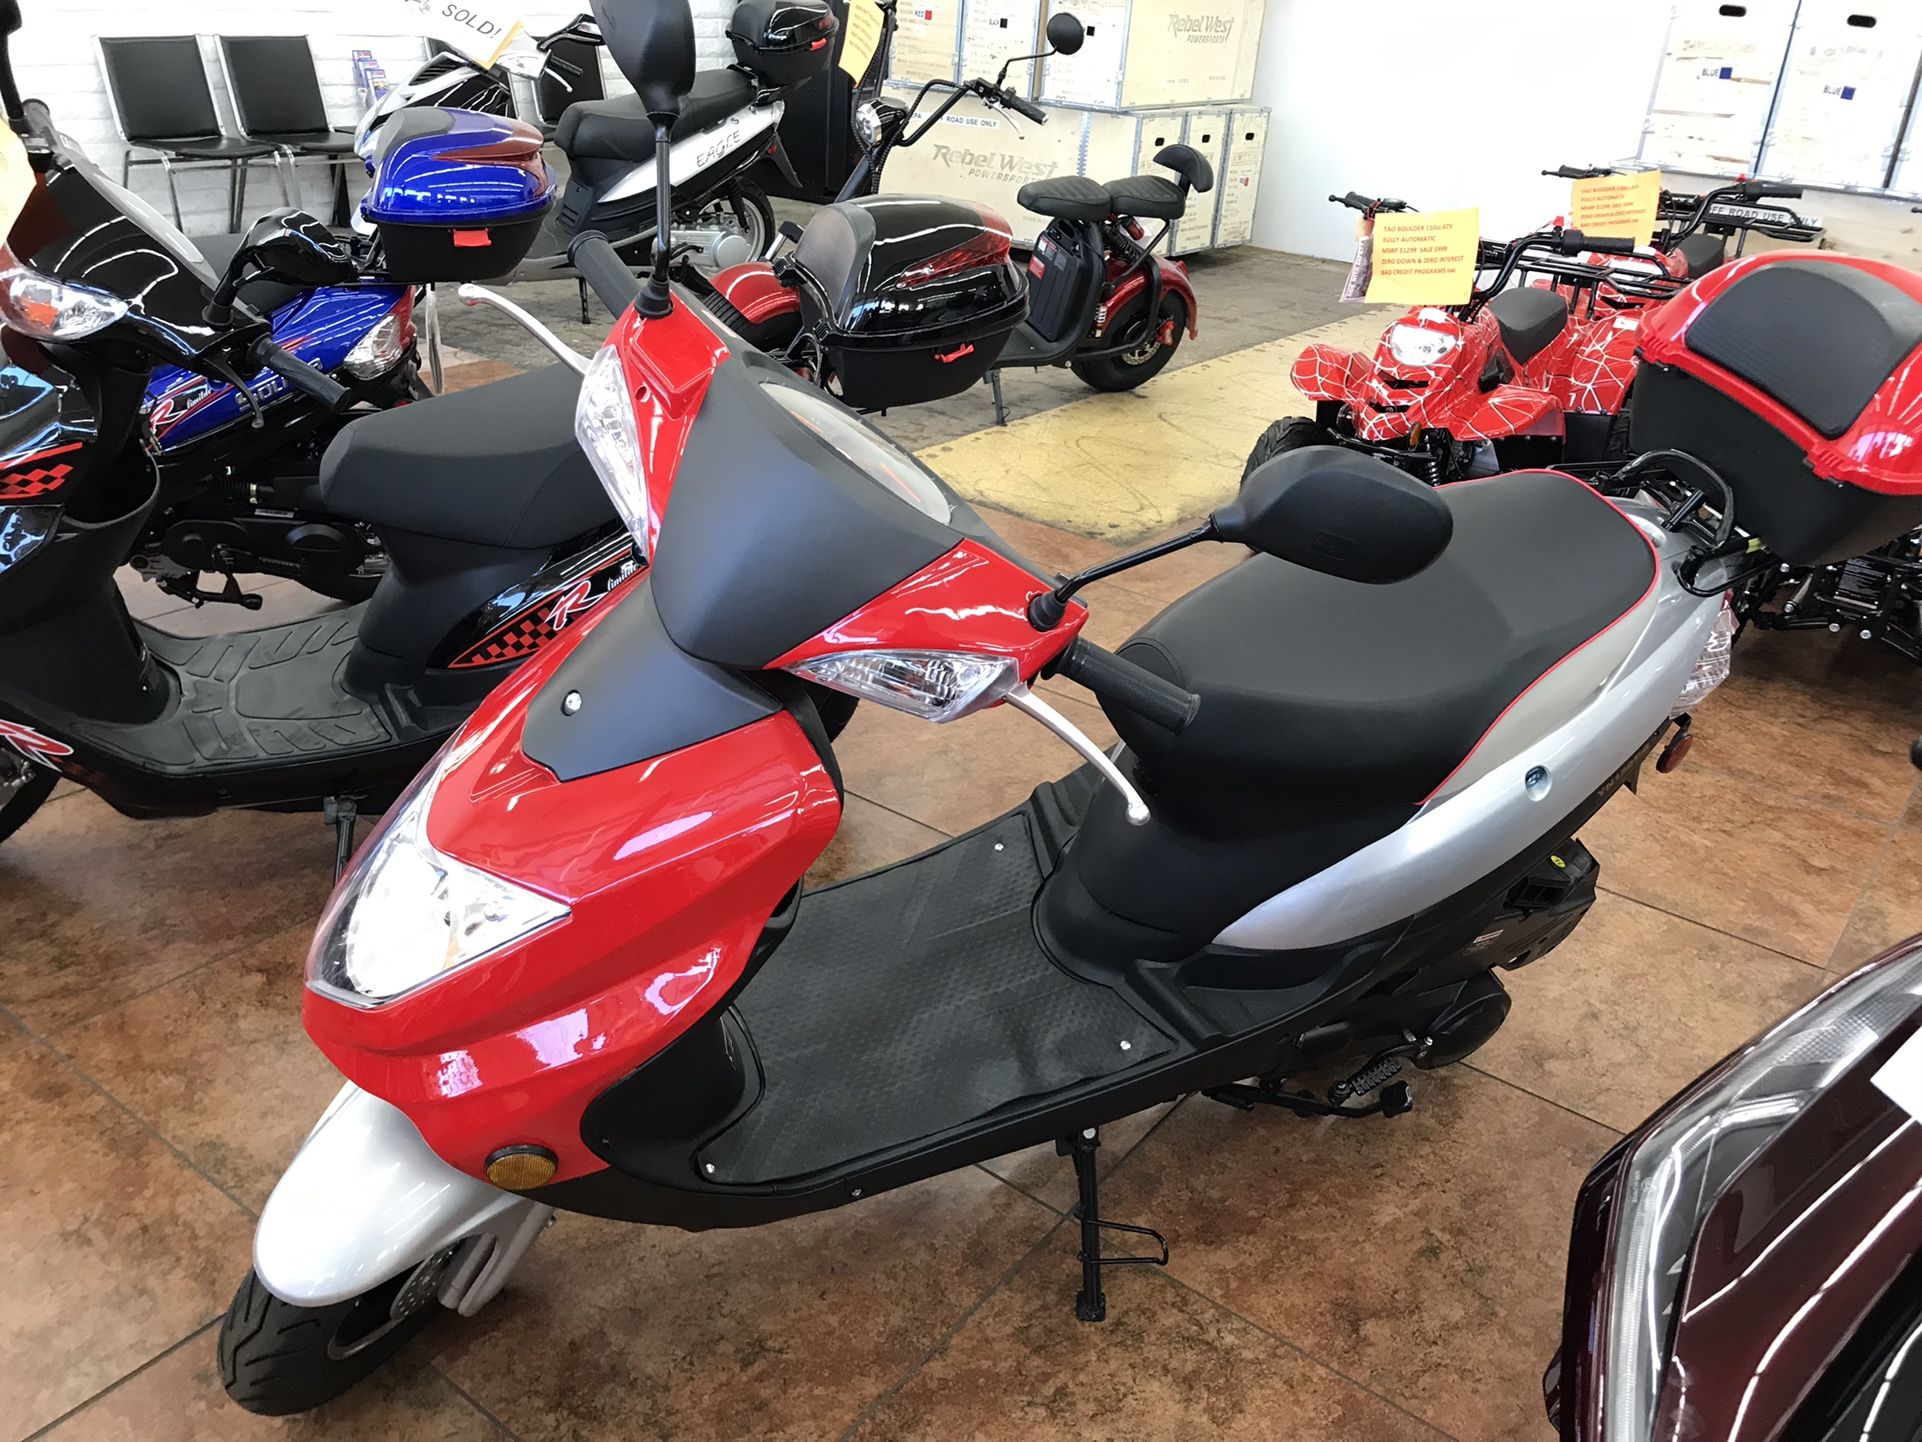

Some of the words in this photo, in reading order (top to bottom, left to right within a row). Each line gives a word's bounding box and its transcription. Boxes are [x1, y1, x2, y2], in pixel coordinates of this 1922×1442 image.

[442, 4, 502, 39] SOLD!
[1168, 14, 1204, 38] Rebel
[1205, 15, 1235, 43] West
[1702, 67, 1719, 77] BLUE
[1823, 84, 1841, 96] BLUE
[981, 119, 997, 127] ONLY
[697, 130, 741, 167] EAGLE
[932, 144, 995, 169] Rebel
[999, 153, 1060, 178] West
[1729, 207, 1757, 219] ROAD
[1763, 212, 1784, 222] USE
